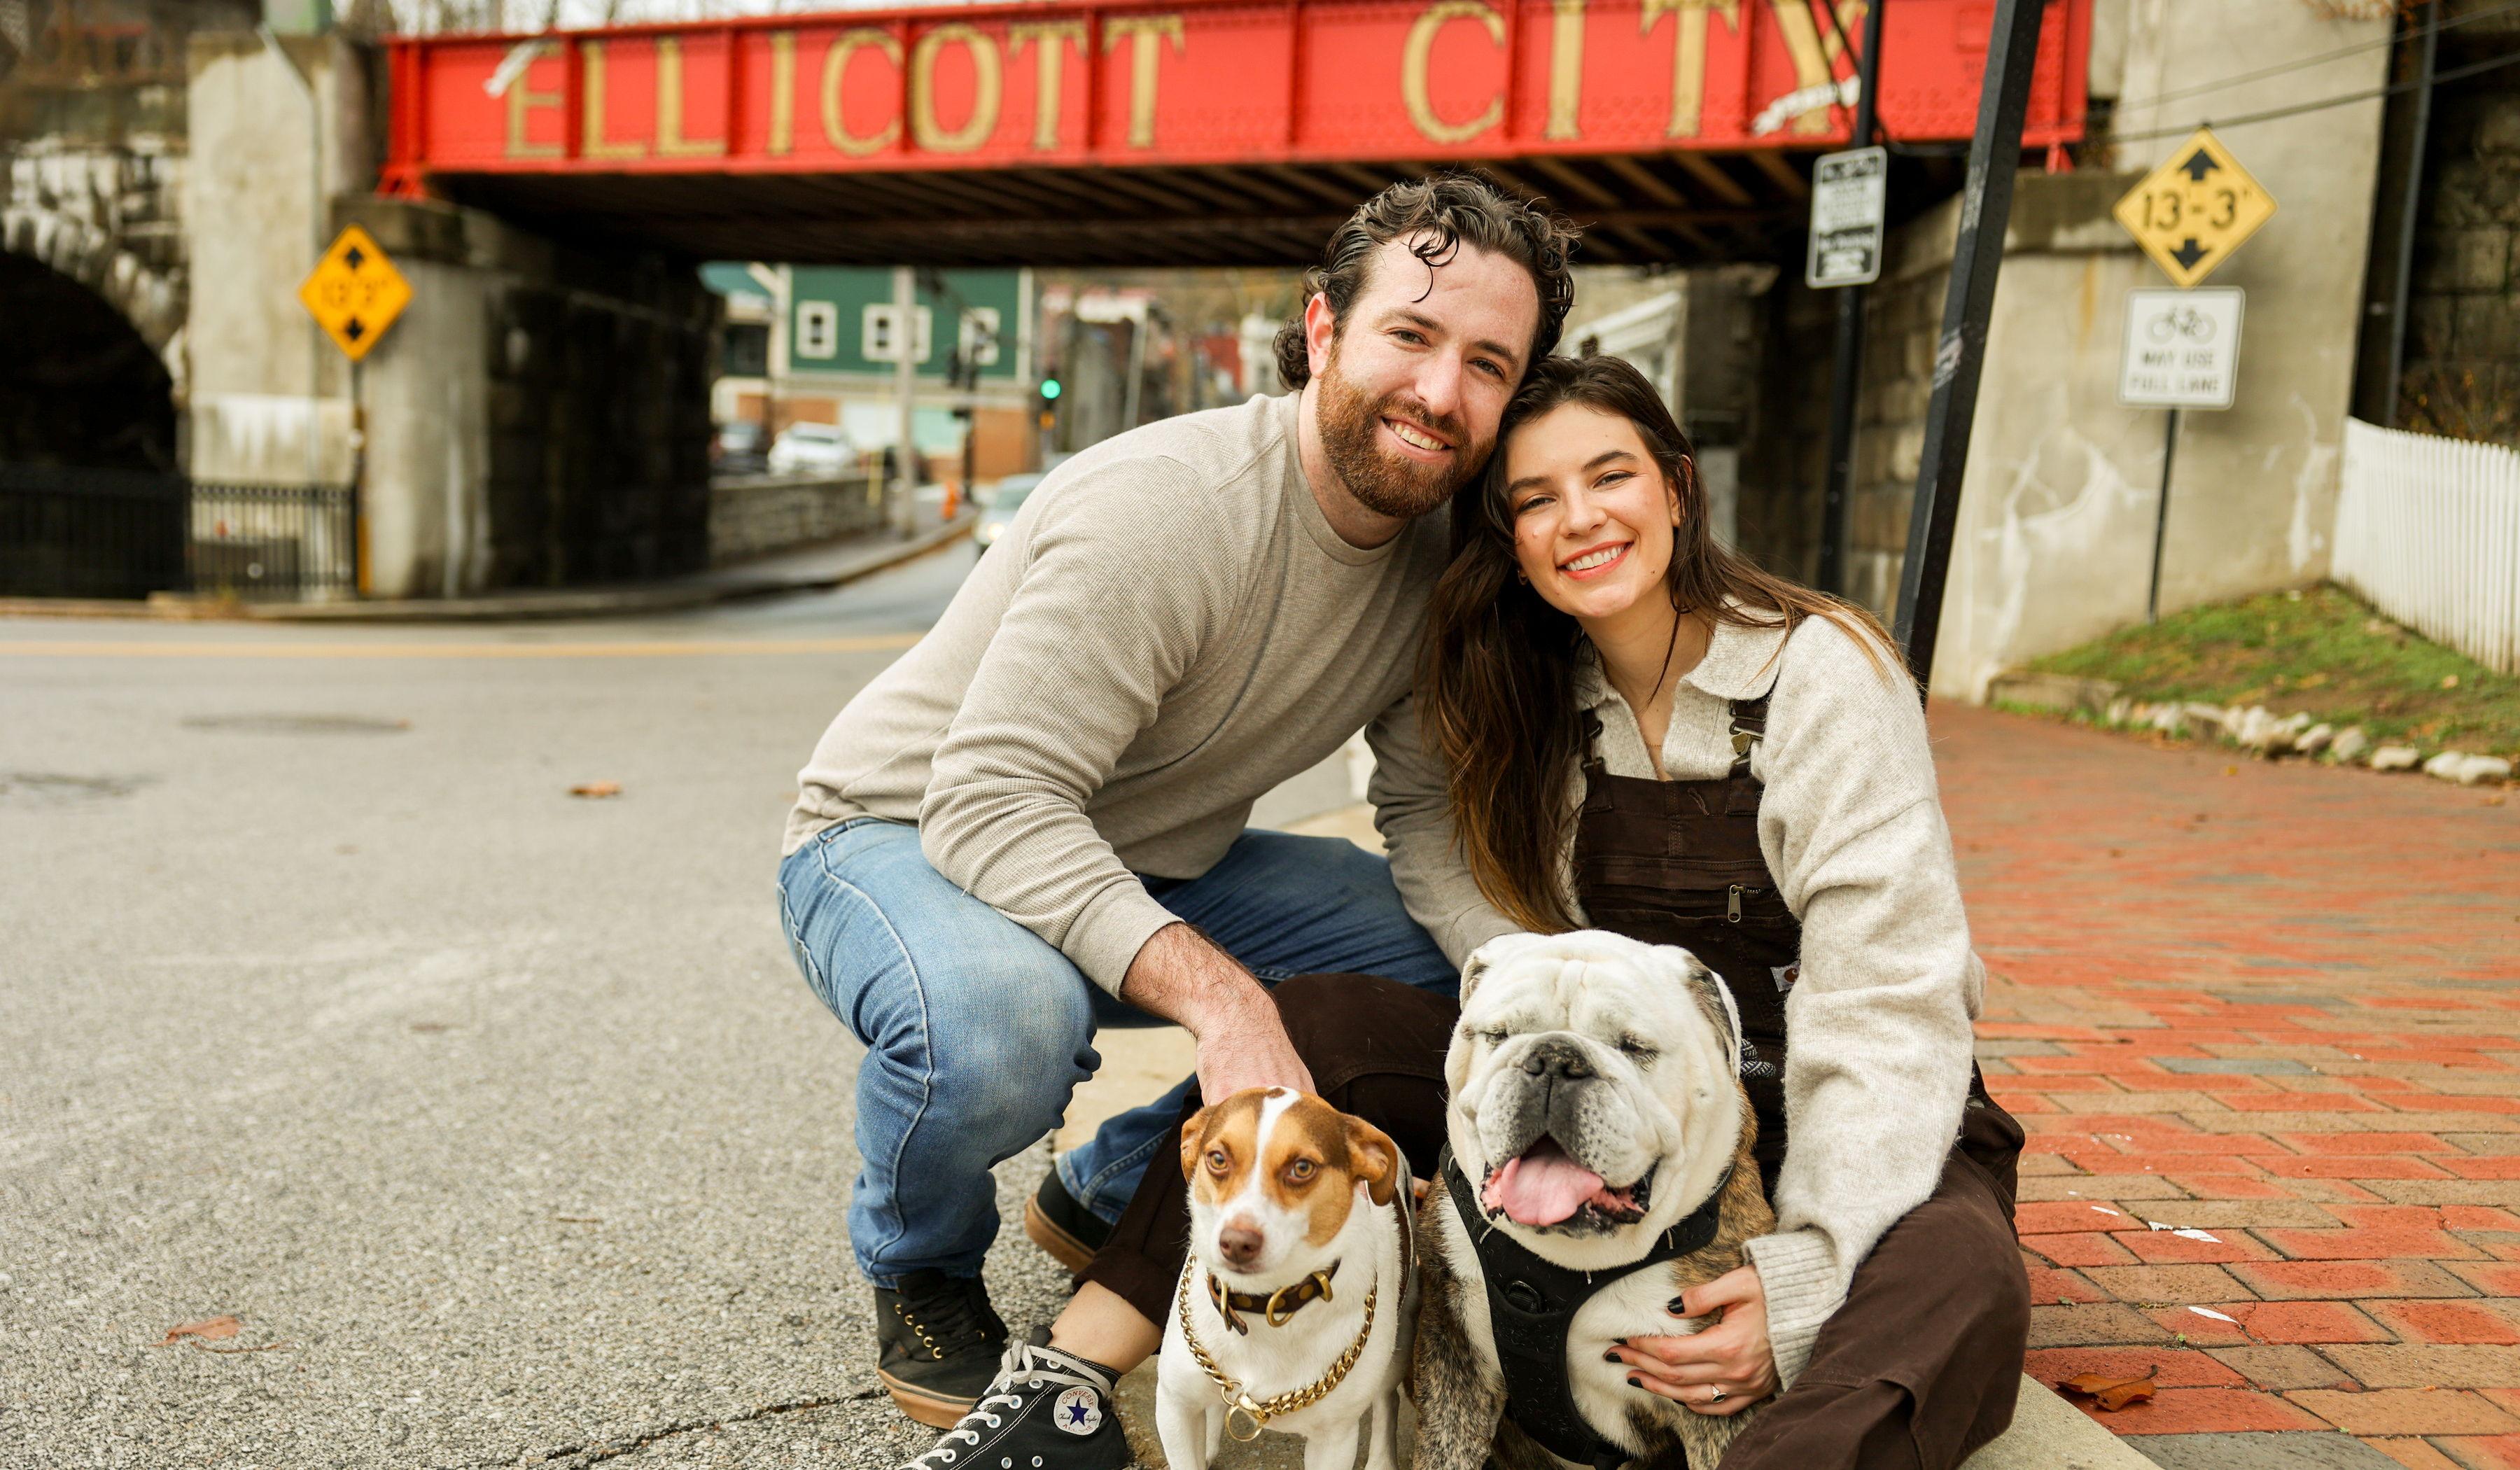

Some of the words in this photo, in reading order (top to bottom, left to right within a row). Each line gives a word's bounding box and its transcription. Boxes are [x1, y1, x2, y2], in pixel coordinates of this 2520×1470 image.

[504, 14, 1186, 160] ELLICOTT
[1401, 0, 1868, 143] CITY
[2141, 351, 2175, 366] MAY
[1062, 1390, 1094, 1408] CONVERSE
[1085, 1415, 1098, 1423] Taylor
